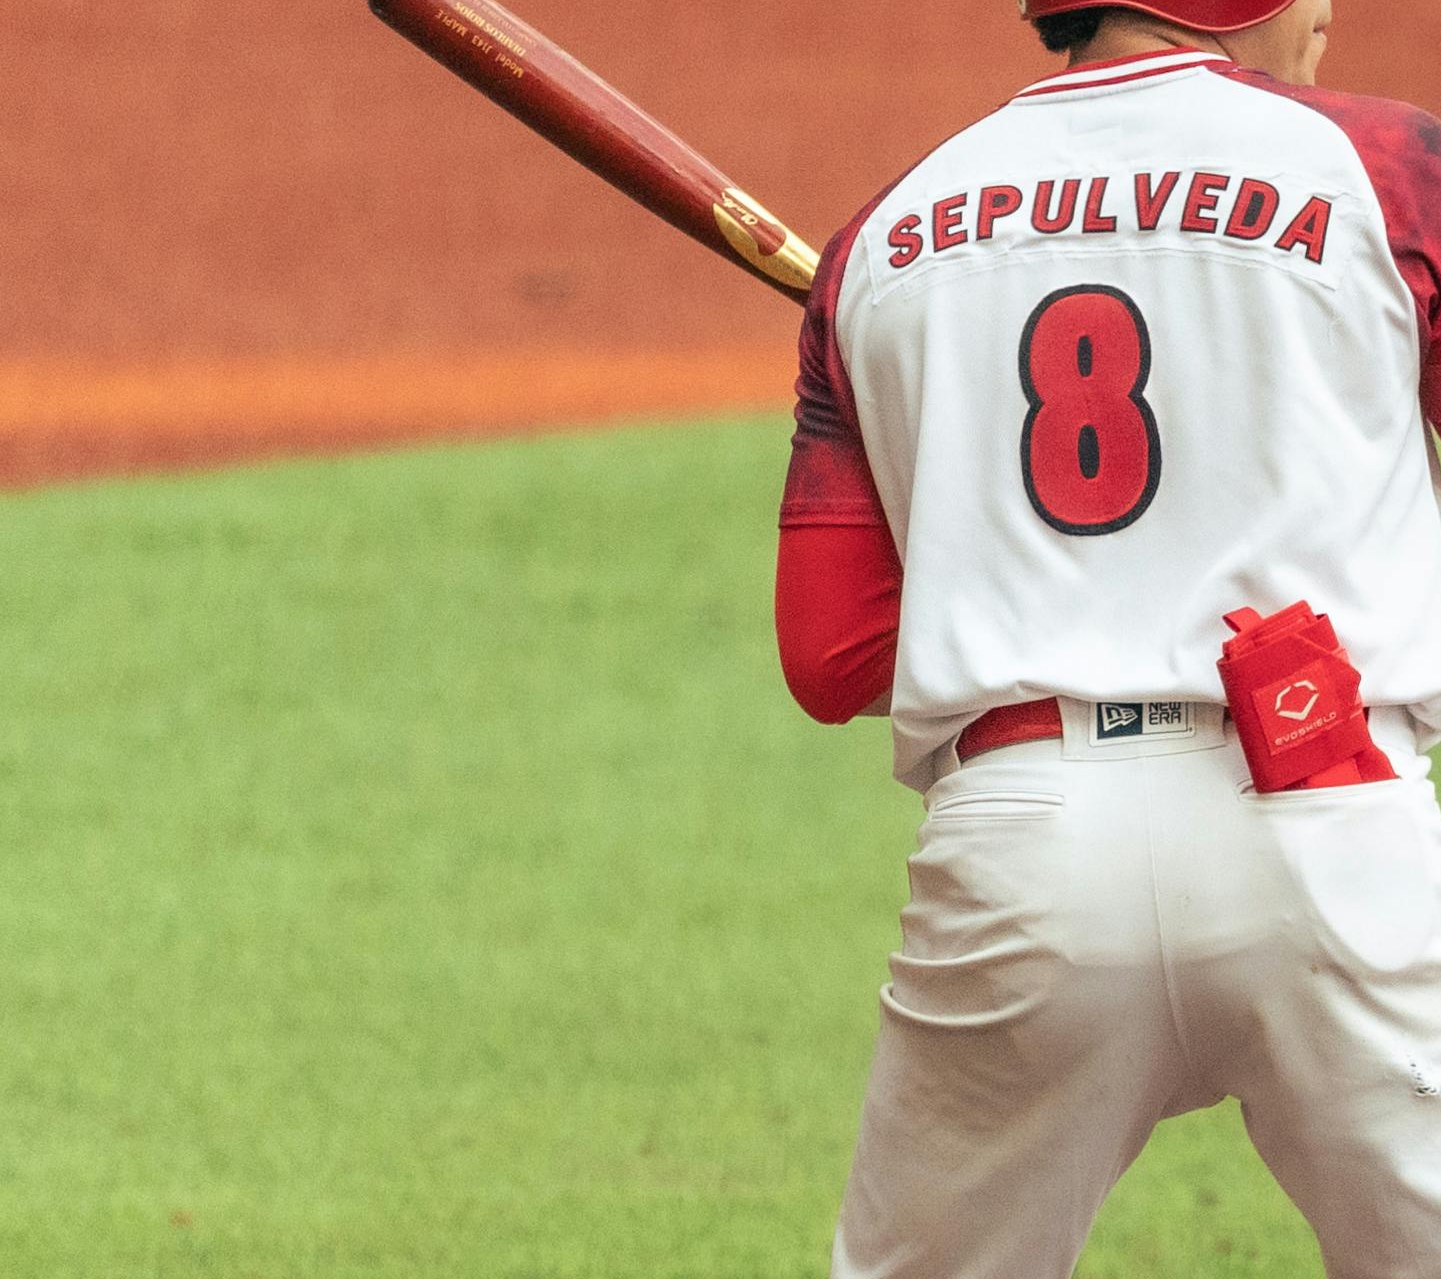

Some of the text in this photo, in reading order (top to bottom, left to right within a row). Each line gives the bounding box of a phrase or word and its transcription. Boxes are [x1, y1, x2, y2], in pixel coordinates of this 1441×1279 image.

[435, 9, 468, 37] MAPLE
[455, 1, 486, 27] ROJOS
[495, 52, 525, 78] Model
[886, 171, 1333, 265] SEPULVEDA
[1018, 283, 1162, 536] 8
[1148, 702, 1182, 712] NEW
[1148, 711, 1182, 725] ERA
